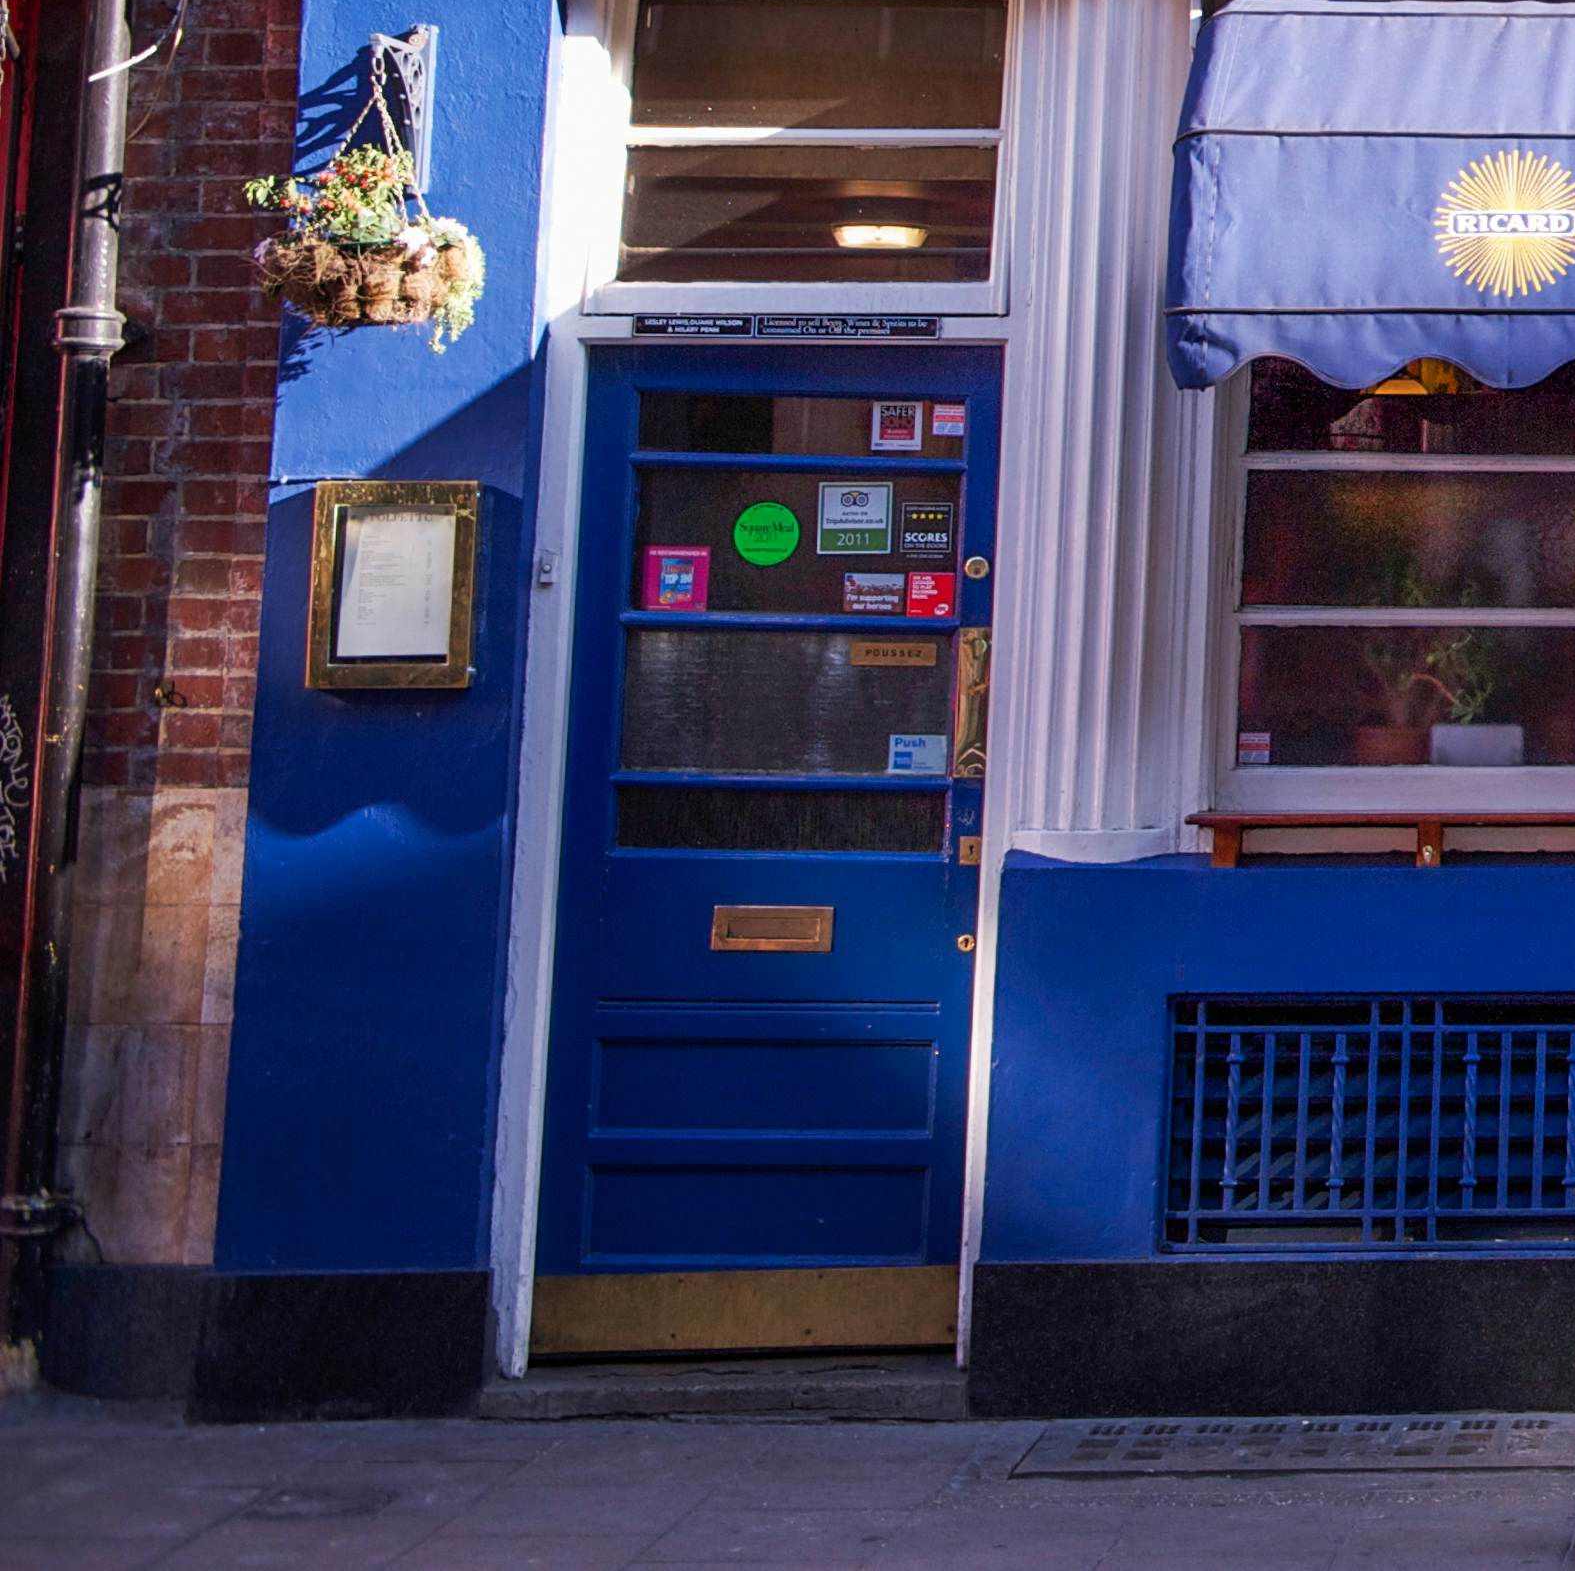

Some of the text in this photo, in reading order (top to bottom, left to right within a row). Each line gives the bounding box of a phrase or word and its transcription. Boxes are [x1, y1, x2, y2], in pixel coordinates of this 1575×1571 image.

[1456, 212, 1572, 233] RICARD
[881, 406, 915, 417] SAFER
[836, 533, 870, 546] 2011
[904, 532, 948, 543] SCORES
[895, 737, 926, 748] Push
